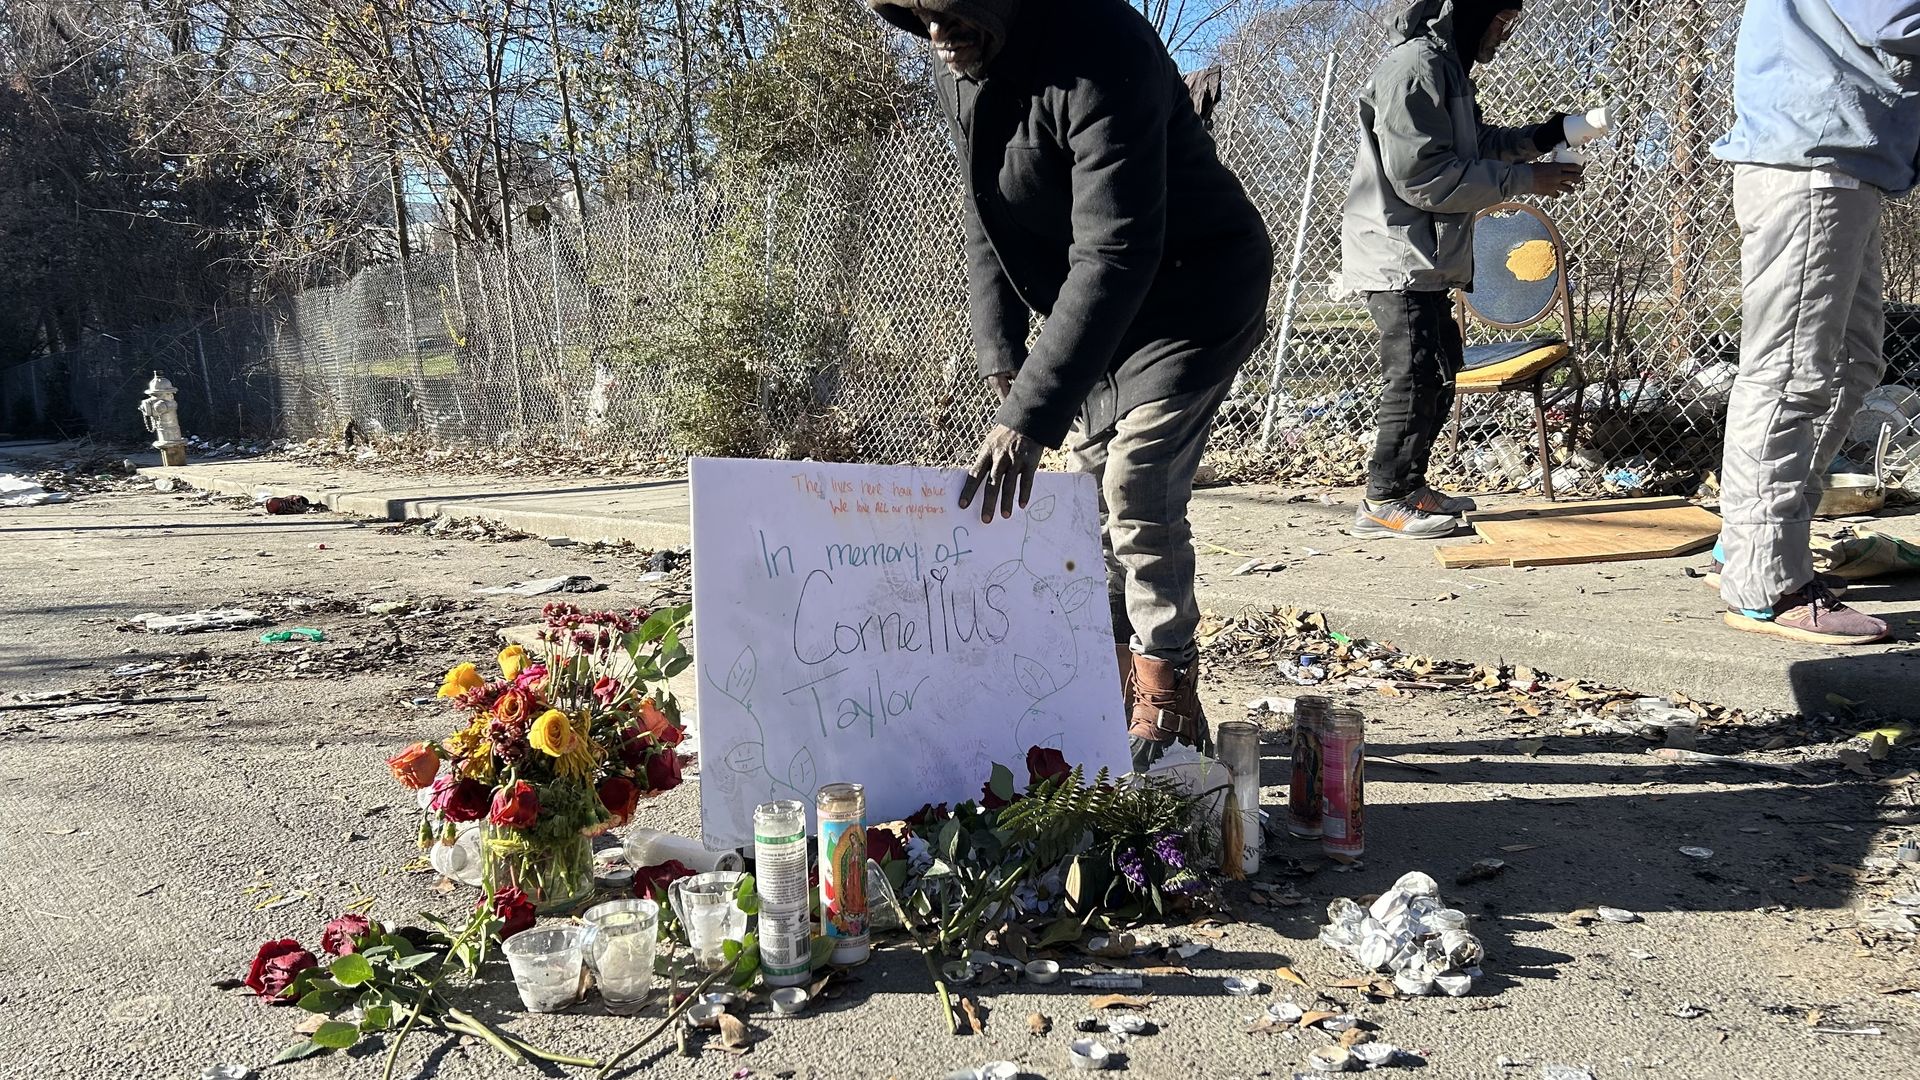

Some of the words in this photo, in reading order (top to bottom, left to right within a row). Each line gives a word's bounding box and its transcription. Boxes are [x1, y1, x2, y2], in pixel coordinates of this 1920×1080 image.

[830, 499, 848, 514] We
[831, 476, 854, 494] lives
[861, 479, 882, 496] here
[759, 530, 794, 579] In
[825, 542, 920, 581] memory
[935, 526, 972, 566] of
[793, 566, 1010, 666] Cornelius
[782, 667, 930, 739] Taylor
